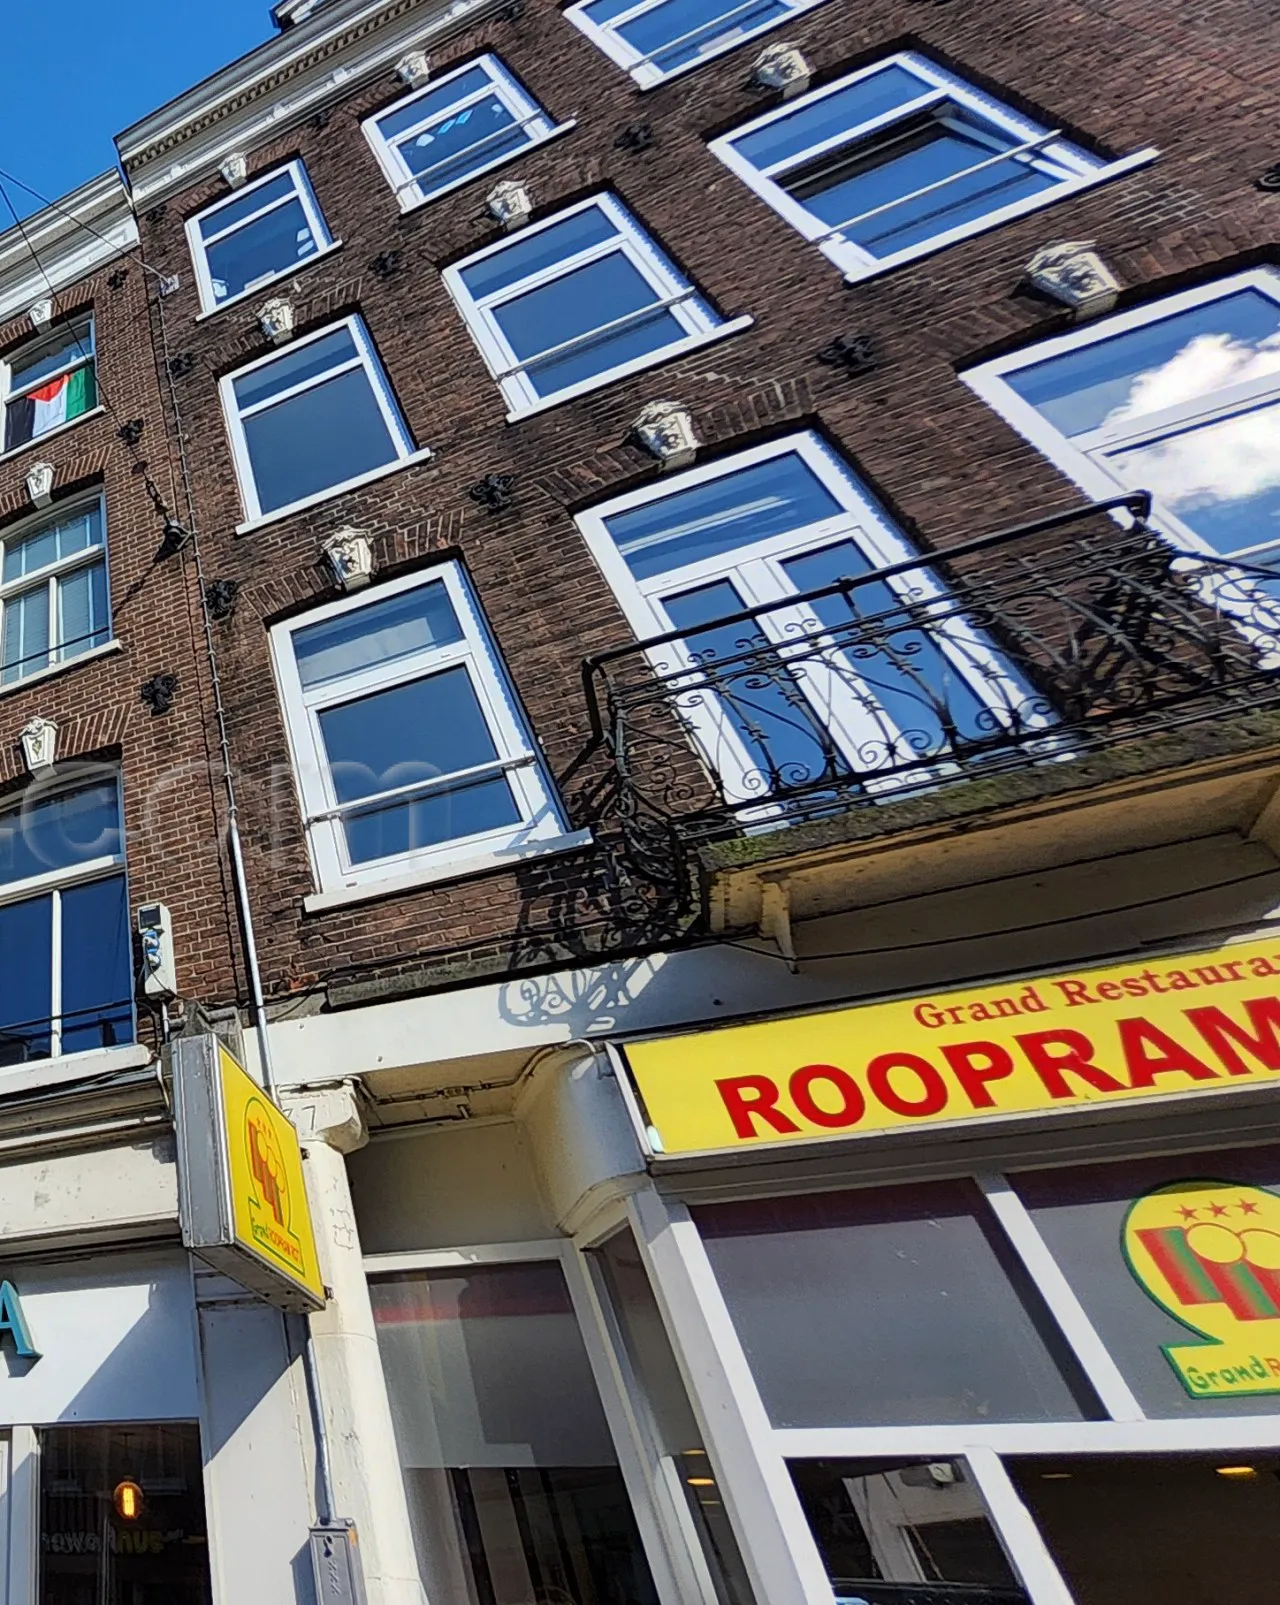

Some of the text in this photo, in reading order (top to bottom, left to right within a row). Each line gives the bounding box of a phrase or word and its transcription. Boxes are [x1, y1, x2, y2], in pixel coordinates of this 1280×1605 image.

[913, 952, 1280, 1029] Grand Restaura
[715, 996, 1280, 1139] ROOPRAM
[1186, 1355, 1270, 1389] Grand
